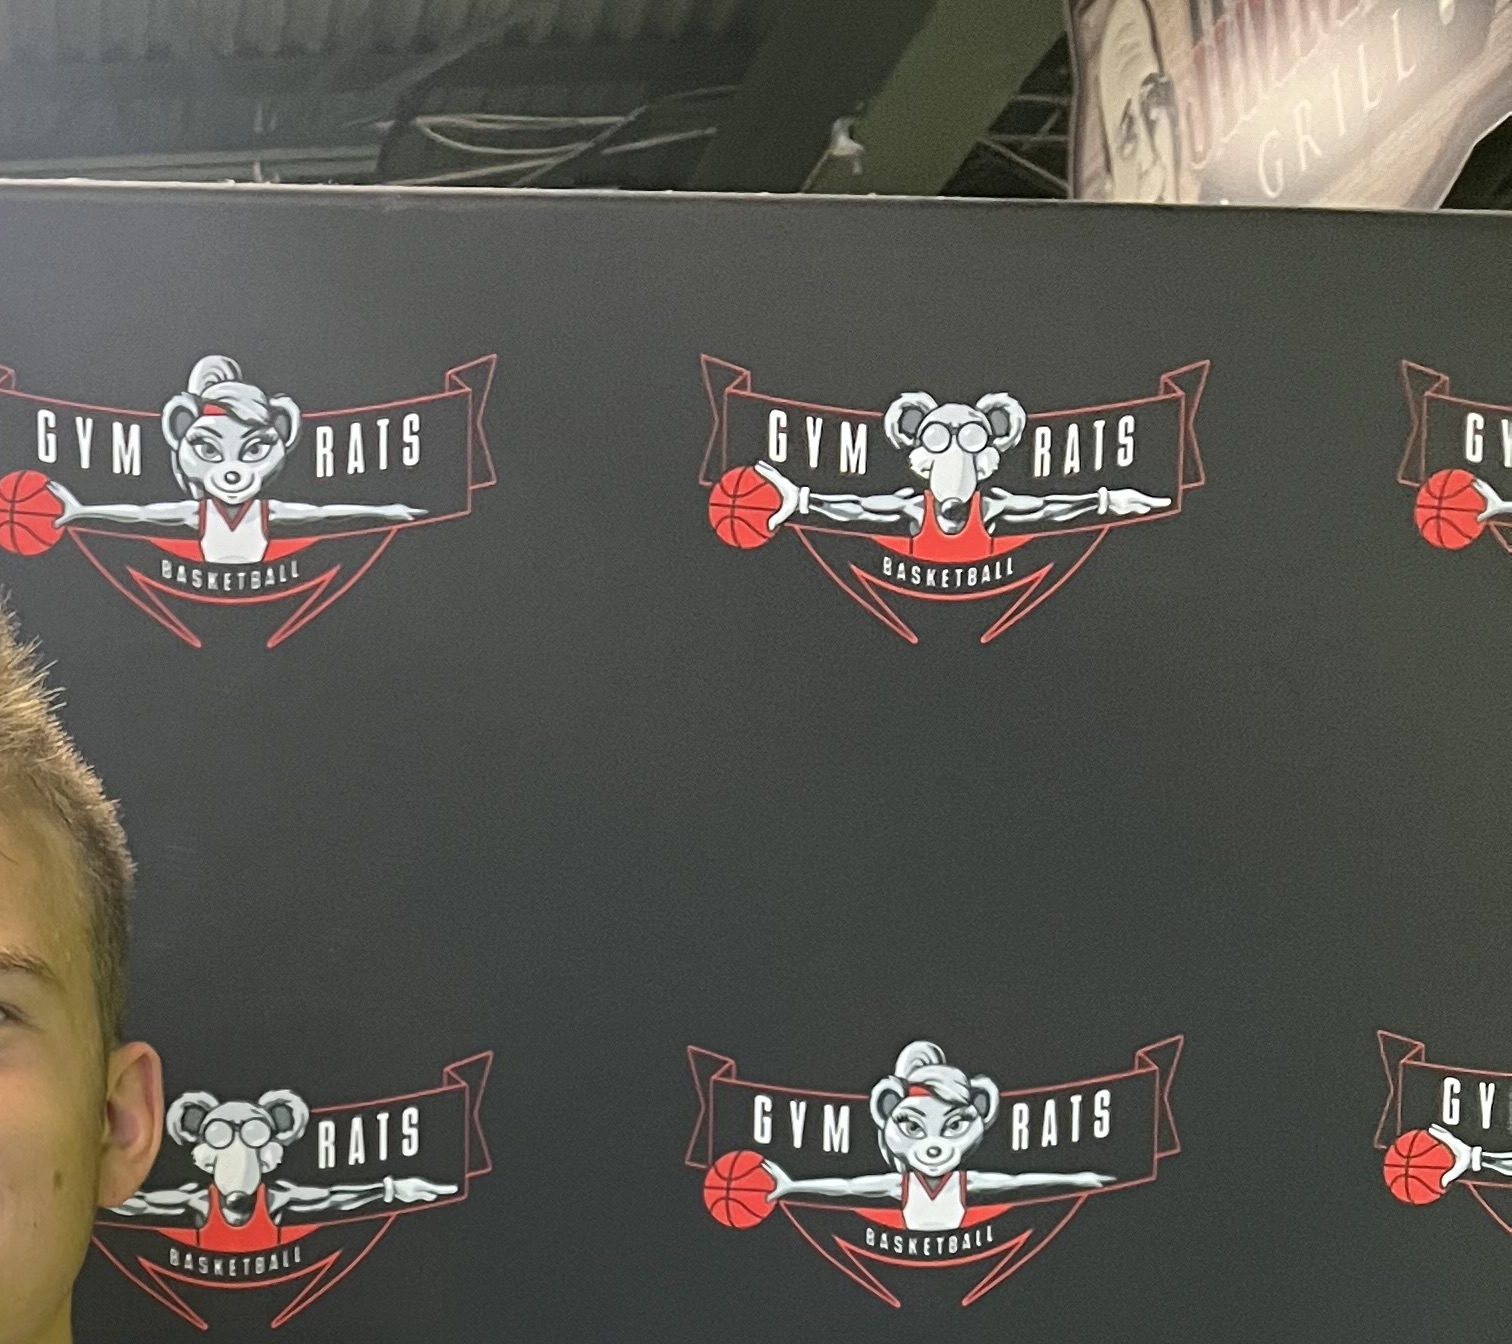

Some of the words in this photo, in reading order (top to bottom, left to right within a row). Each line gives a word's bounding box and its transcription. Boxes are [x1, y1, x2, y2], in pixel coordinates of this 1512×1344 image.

[1258, 8, 1416, 198] GRILL
[37, 408, 141, 475] GYM
[316, 412, 420, 477] RATS
[768, 408, 867, 475] GYM
[1034, 415, 1134, 477] RATS
[162, 560, 298, 591] BASKETBALL
[883, 557, 1013, 587] BASKETBALL
[754, 1095, 849, 1153] GYM
[1012, 1090, 1110, 1150] RATS
[1443, 1077, 1512, 1132] GY
[319, 1107, 418, 1169] RATS
[169, 1247, 301, 1278] BASKETBALL
[866, 1226, 992, 1255] BASKETBALL
